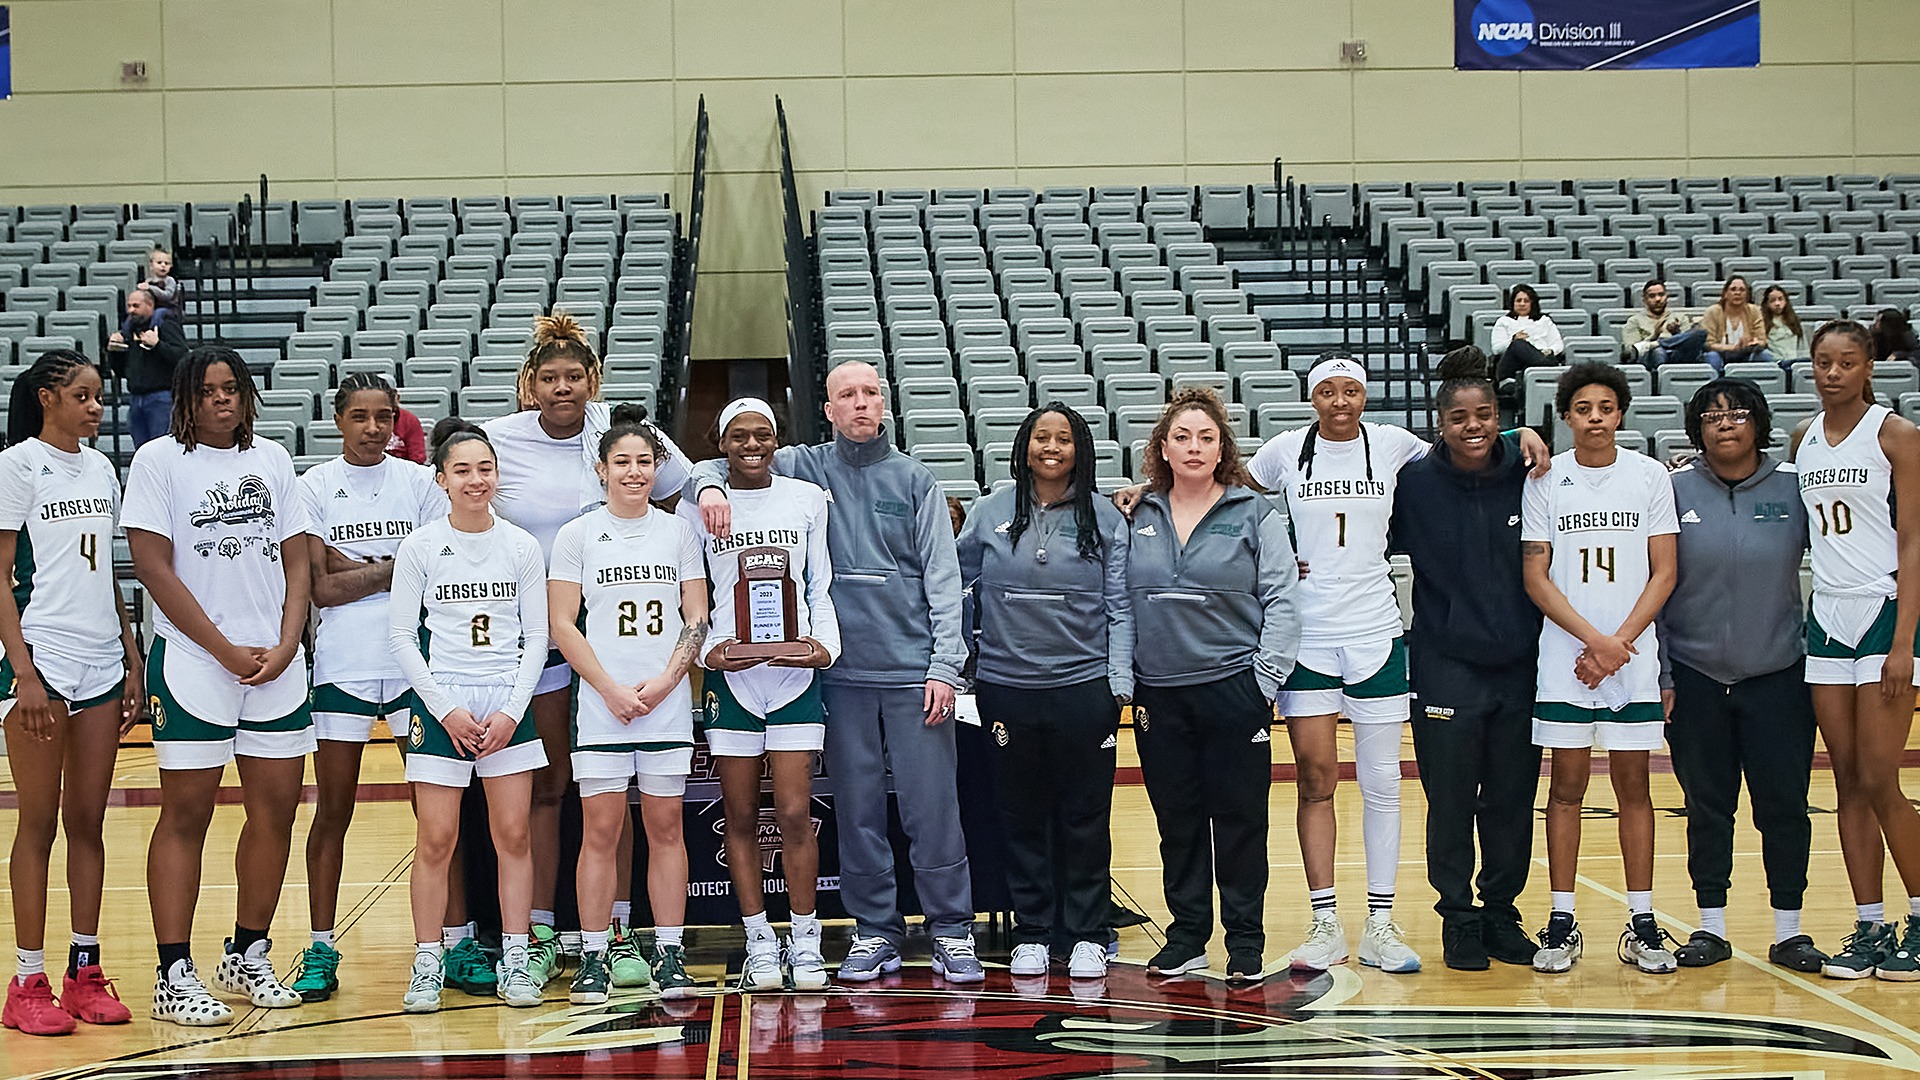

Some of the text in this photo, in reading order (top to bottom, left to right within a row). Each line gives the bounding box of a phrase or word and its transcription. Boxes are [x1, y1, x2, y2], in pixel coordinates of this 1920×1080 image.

[1478, 22, 1621, 41] NCAA Division III
[1298, 480, 1384, 498] JERSEY CITY
[1800, 468, 1868, 490] JERSEY CITY
[41, 499, 92, 520] JERSEY
[203, 489, 265, 515] Holiday
[1558, 511, 1639, 531] JERSEY CITY
[1815, 500, 1852, 536] 10
[329, 520, 413, 541] JERSEY CITY
[1335, 513, 1345, 547] 1
[80, 533, 96, 571] 4
[712, 529, 798, 554] JERSEY CITY
[745, 553, 785, 568] ECAC
[1579, 547, 1615, 583] 14
[597, 564, 677, 584] JERSEY CITY
[435, 581, 517, 600] JERSEY CITY
[617, 600, 664, 637] 23
[471, 614, 491, 647] 2
[687, 878, 788, 897] ROTECT HOU
